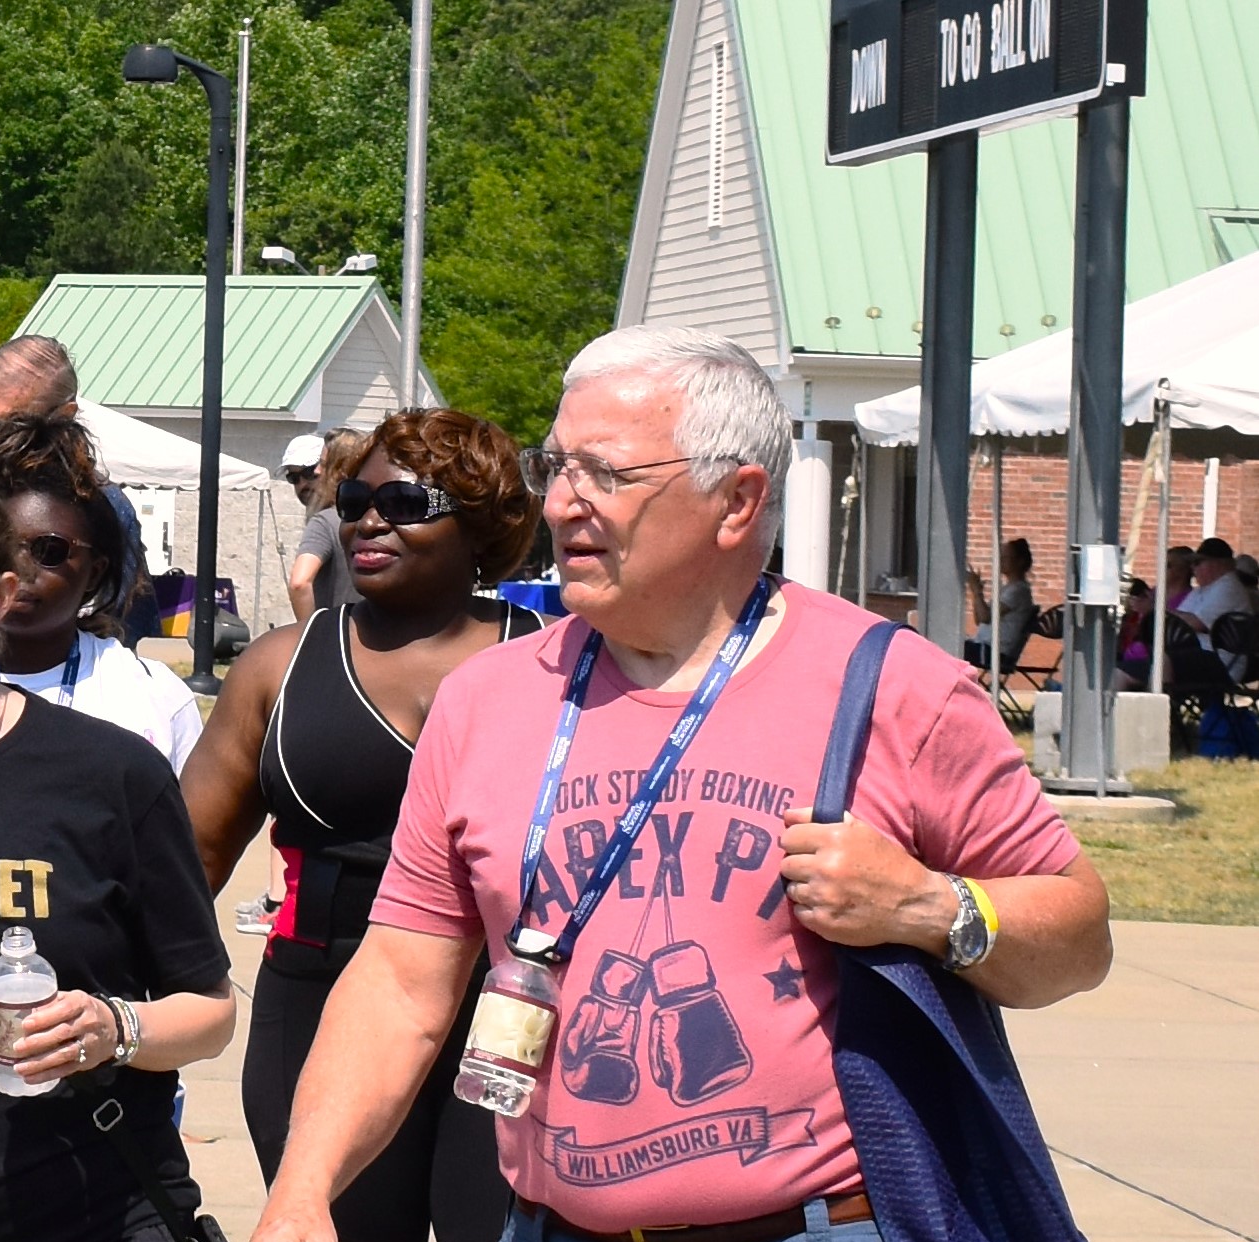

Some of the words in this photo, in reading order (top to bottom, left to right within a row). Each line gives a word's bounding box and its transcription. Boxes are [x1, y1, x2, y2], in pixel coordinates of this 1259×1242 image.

[940, 18, 958, 88] TO
[961, 11, 981, 82] GO
[991, 0, 1026, 73] BALL
[1029, 0, 1050, 63] ON
[850, 38, 887, 114] DOWN
[550, 773, 599, 817] OCK
[607, 768, 695, 805] STDY
[700, 768, 795, 820] BOXING
[567, 1123, 720, 1178] WILLIAMSBURG
[727, 1118, 753, 1143] VA
